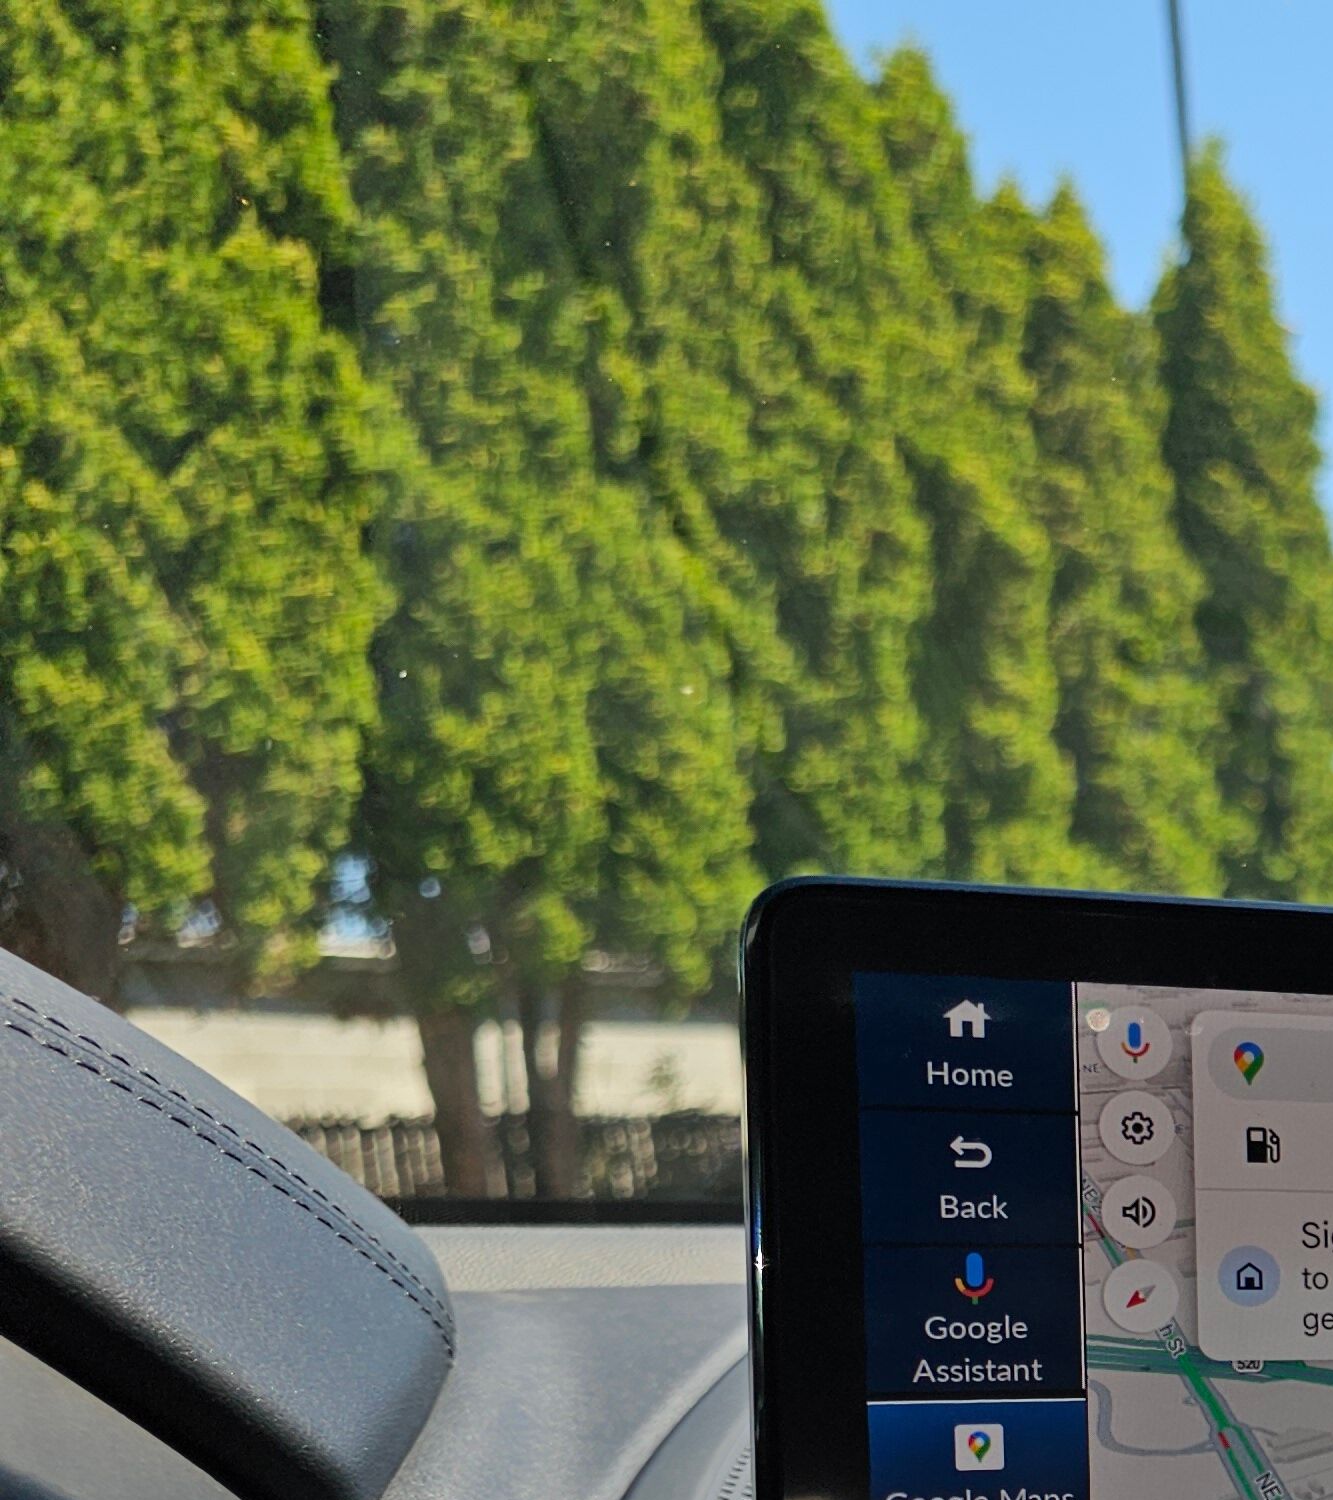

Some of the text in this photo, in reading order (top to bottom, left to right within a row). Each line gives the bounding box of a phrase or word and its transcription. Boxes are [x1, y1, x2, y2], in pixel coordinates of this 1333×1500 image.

[926, 1061, 1014, 1088] Home
[940, 1194, 1009, 1220] Back
[1302, 1267, 1329, 1291] to
[924, 1315, 1029, 1344] Google
[912, 1357, 1044, 1383] Assistant
